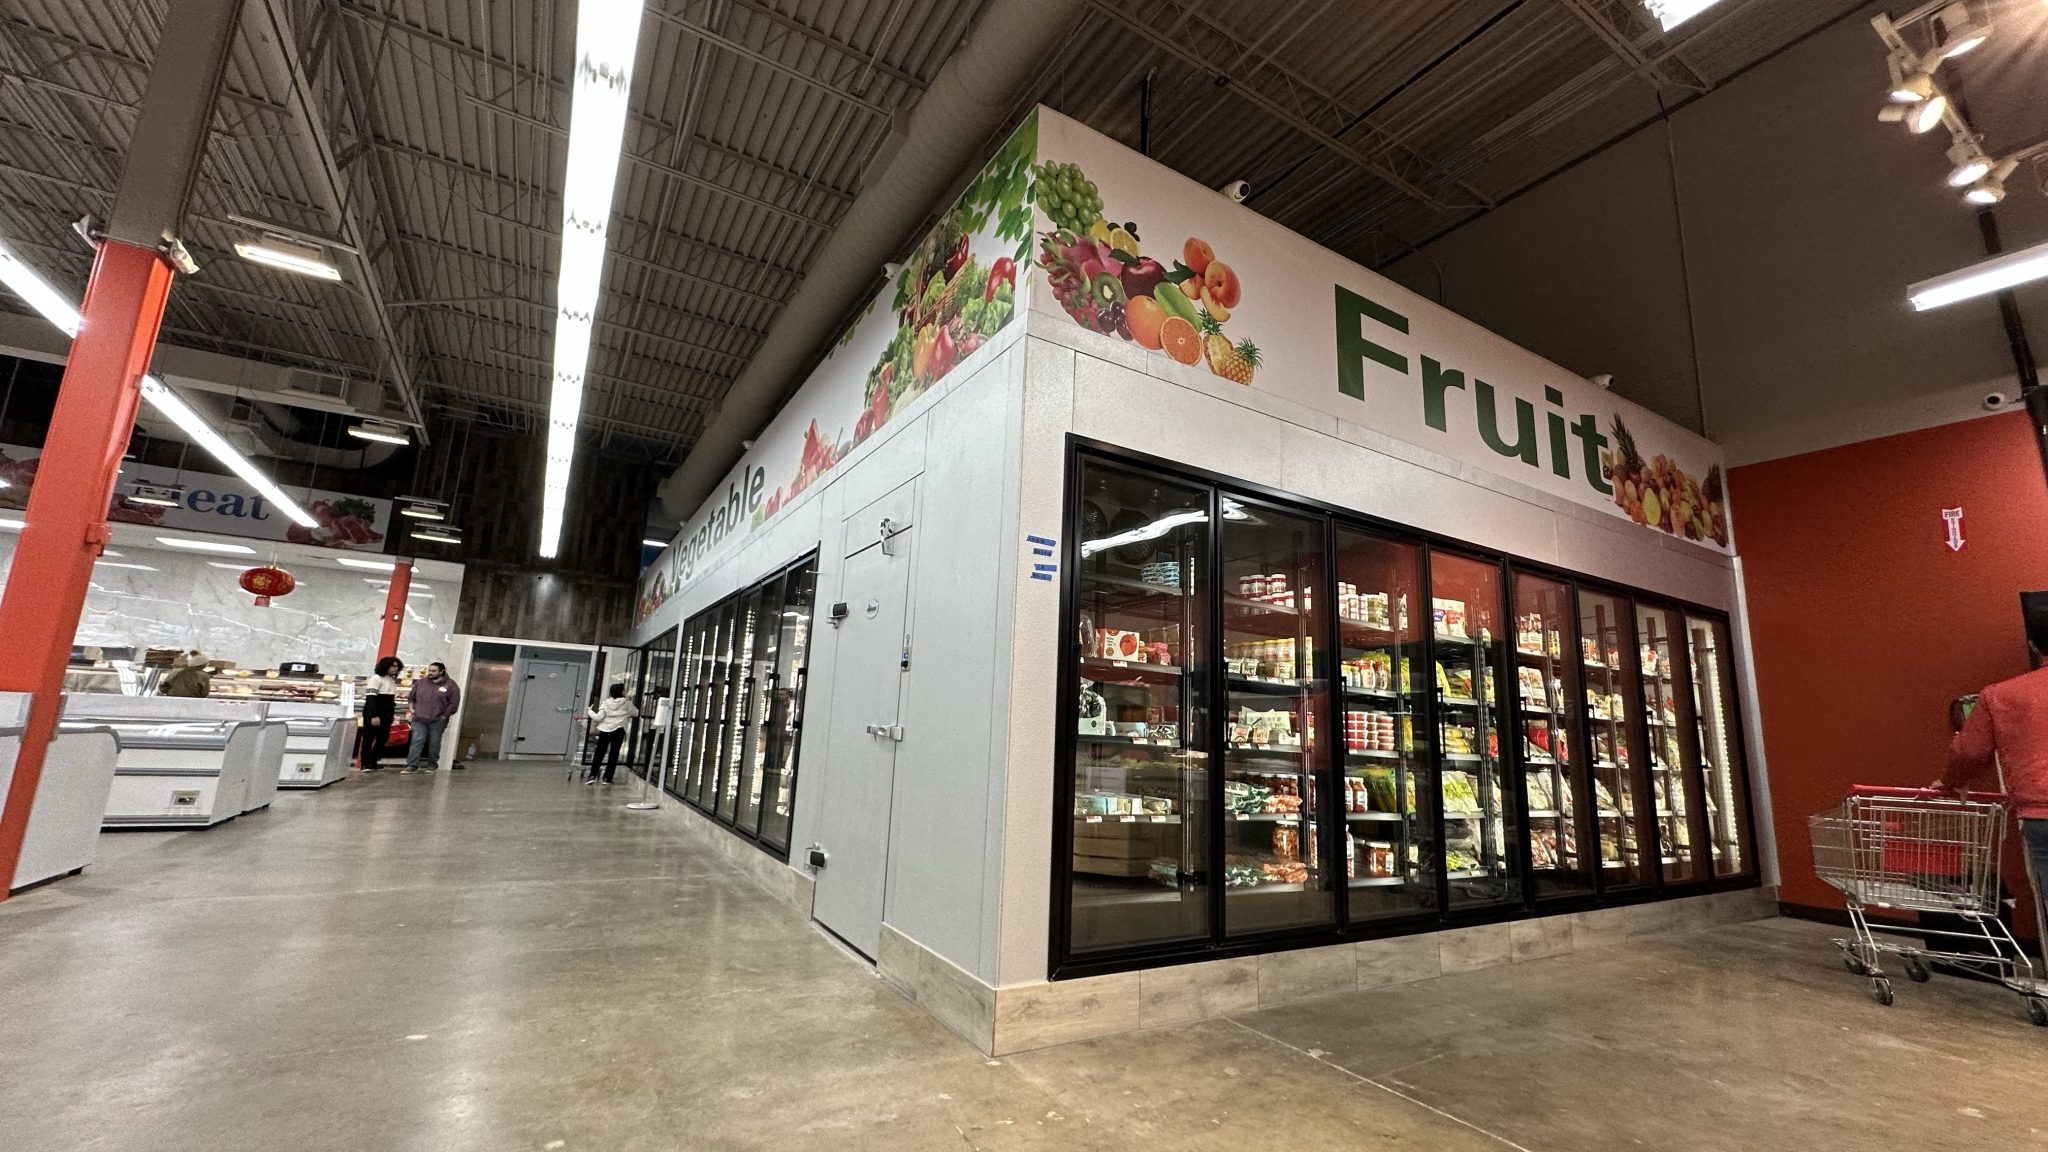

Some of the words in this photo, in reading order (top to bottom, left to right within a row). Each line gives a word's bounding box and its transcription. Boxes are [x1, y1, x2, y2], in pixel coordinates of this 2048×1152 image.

[1335, 284, 1613, 496] Fruit
[134, 486, 270, 520] eat
[671, 464, 765, 594] Vegetable
[1944, 510, 1960, 518] FIRE
